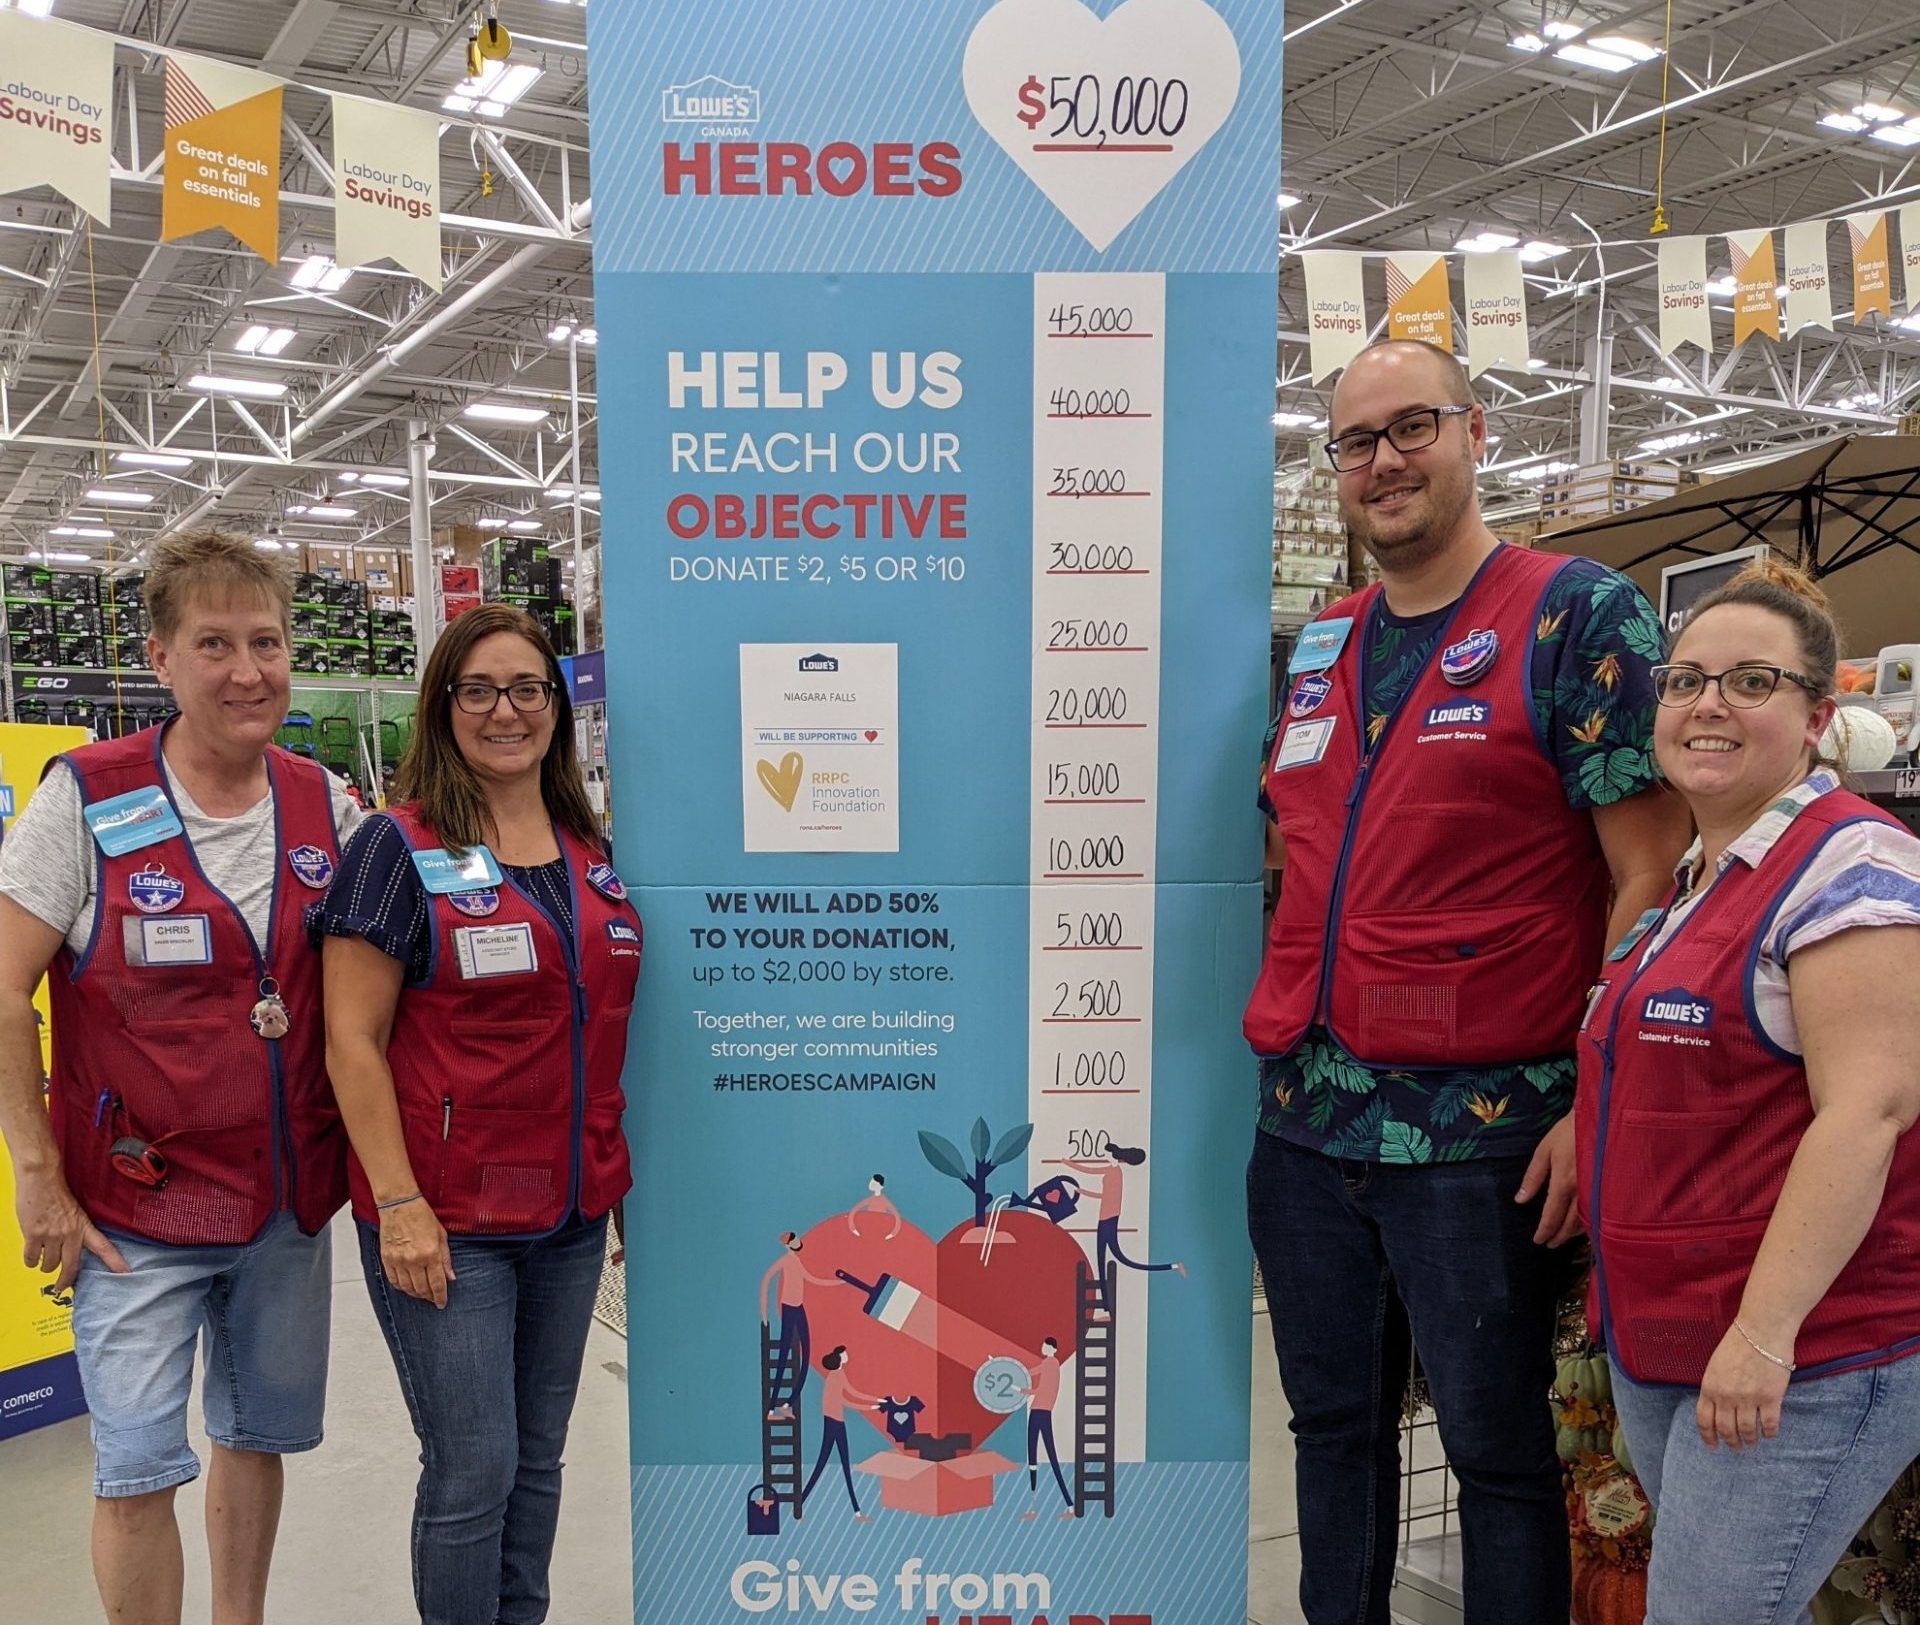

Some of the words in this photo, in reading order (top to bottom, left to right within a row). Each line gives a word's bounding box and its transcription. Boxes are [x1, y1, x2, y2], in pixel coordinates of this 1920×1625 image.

[0, 82, 63, 107] abour
[67, 95, 103, 121] Day
[673, 94, 750, 118] LOWE'S
[1016, 74, 1189, 149] $50,000
[0, 97, 102, 144] Savings
[701, 127, 750, 137] CANADA
[176, 139, 224, 165] Great
[227, 152, 269, 176] deals
[663, 141, 962, 197] HEROES
[199, 165, 220, 181] on
[222, 167, 248, 188] fall
[343, 158, 398, 185] Labour
[402, 172, 432, 197] Day
[183, 178, 261, 208] essentials
[344, 177, 433, 219] Savings
[1788, 266, 1810, 277] Labour
[1811, 264, 1824, 273] Day
[1662, 283, 1687, 294] Labour
[1689, 280, 1704, 291] Day
[1789, 276, 1826, 292] Savings
[1312, 300, 1341, 312] Labour
[1343, 301, 1360, 315] Day
[1470, 298, 1500, 310] Labour
[1503, 296, 1521, 307] Day
[1663, 293, 1705, 309] Savings
[1048, 304, 1133, 338] 45,000
[1314, 314, 1362, 333] Savings
[1395, 311, 1421, 323] Great
[1423, 309, 1445, 321] deals
[1472, 310, 1522, 327] Savings
[1407, 325, 1419, 334] on
[1420, 323, 1434, 333] fall
[668, 351, 848, 409] HELP
[871, 351, 963, 409] US
[1050, 387, 1131, 420] 40,000
[671, 432, 837, 474] REACH
[853, 432, 962, 474] OUR
[1051, 467, 1126, 499] 35,000
[666, 493, 968, 540] OBJECTIVE
[670, 556, 790, 582] DONATE
[798, 554, 832, 584] $2,
[840, 554, 867, 582] $5
[875, 556, 917, 582] OR
[926, 554, 966, 582] $10
[1049, 542, 1133, 573] 30,000
[1049, 619, 1128, 650] 25,000
[802, 660, 835, 670] LOWE'S
[22, 677, 69, 689] EGO
[784, 692, 827, 702] NIAGARA
[830, 692, 857, 702] FALLS
[1046, 687, 1127, 725] 20,000
[1428, 704, 1485, 725] LOWE'S
[759, 732, 781, 741] WILL
[784, 732, 796, 741] BE
[798, 732, 857, 741] SUPPORTING
[1295, 729, 1311, 740] TOM
[1417, 732, 1453, 743] Customer
[1454, 731, 1487, 741] Service
[812, 773, 849, 784] RRPC
[1048, 763, 1120, 798] 15,000
[812, 786, 879, 798] Innovation
[96, 813, 120, 825] Give
[121, 805, 146, 818] from
[812, 800, 885, 812] Foundation
[422, 860, 445, 868] Give
[1049, 835, 1124, 871] 10,000
[705, 892, 748, 914] WE
[754, 892, 819, 914] WILL
[826, 892, 882, 914] ADD
[888, 892, 939, 914] 50%
[156, 925, 190, 936] CHRIS
[476, 934, 519, 945] MICHELINE
[690, 928, 727, 949] TO
[733, 928, 806, 949] YOUR
[813, 928, 956, 952] DONATION,
[1058, 912, 1122, 947] 5,000
[693, 966, 724, 986] up
[731, 963, 755, 982] to
[763, 958, 845, 985] $2,000
[854, 960, 882, 986] by
[889, 964, 954, 982] store.
[693, 1010, 791, 1033] Together,
[796, 1013, 826, 1029] we
[832, 1013, 866, 1029] are
[872, 1009, 955, 1033] building
[1645, 999, 1706, 1024] LOWE'S
[711, 1039, 799, 1061] stronger
[804, 1038, 938, 1057] communities
[1638, 1031, 1671, 1043] Customer
[1673, 1034, 1710, 1046] Service
[713, 1072, 937, 1092] #HEROESCAMPAIGN
[985, 1372, 1014, 1397] $2
[3, 1386, 54, 1410] comerco
[730, 1558, 879, 1613] Give
[894, 1557, 1051, 1611] from
